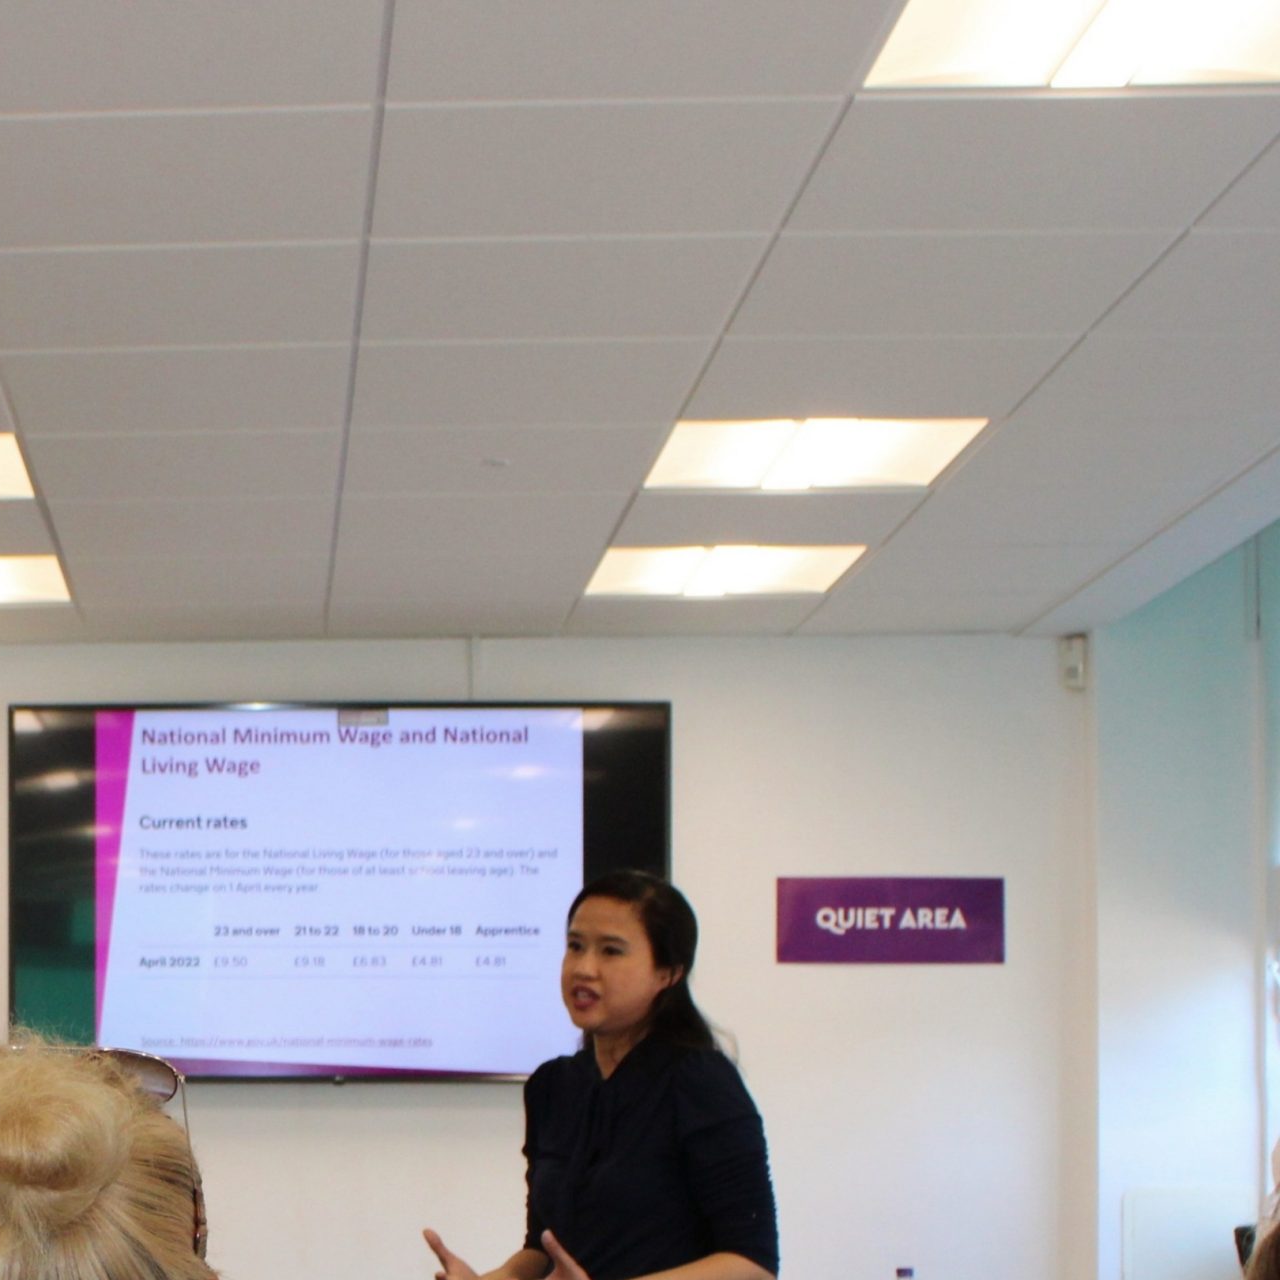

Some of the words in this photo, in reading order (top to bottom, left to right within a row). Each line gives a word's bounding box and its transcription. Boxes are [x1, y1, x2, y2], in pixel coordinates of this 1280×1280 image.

[141, 727, 227, 745] National
[232, 727, 331, 745] Minimum
[337, 726, 393, 748] Wage
[399, 726, 437, 745] and
[443, 726, 529, 744] National
[140, 757, 199, 778] Living
[205, 757, 261, 778] Wage
[139, 815, 203, 830] Current
[206, 815, 248, 830] rates
[815, 907, 896, 935] QUIET
[899, 907, 968, 930] AREA
[213, 926, 230, 937] 23
[232, 926, 253, 937] and
[255, 926, 281, 937] over
[293, 926, 307, 937] 21
[308, 926, 322, 937] to
[323, 926, 340, 937] 22
[367, 926, 380, 937] to
[382, 926, 399, 937] 20
[411, 926, 447, 937] Under
[475, 925, 541, 940] Apprentice
[139, 956, 167, 970] April
[168, 956, 201, 968] 2022
